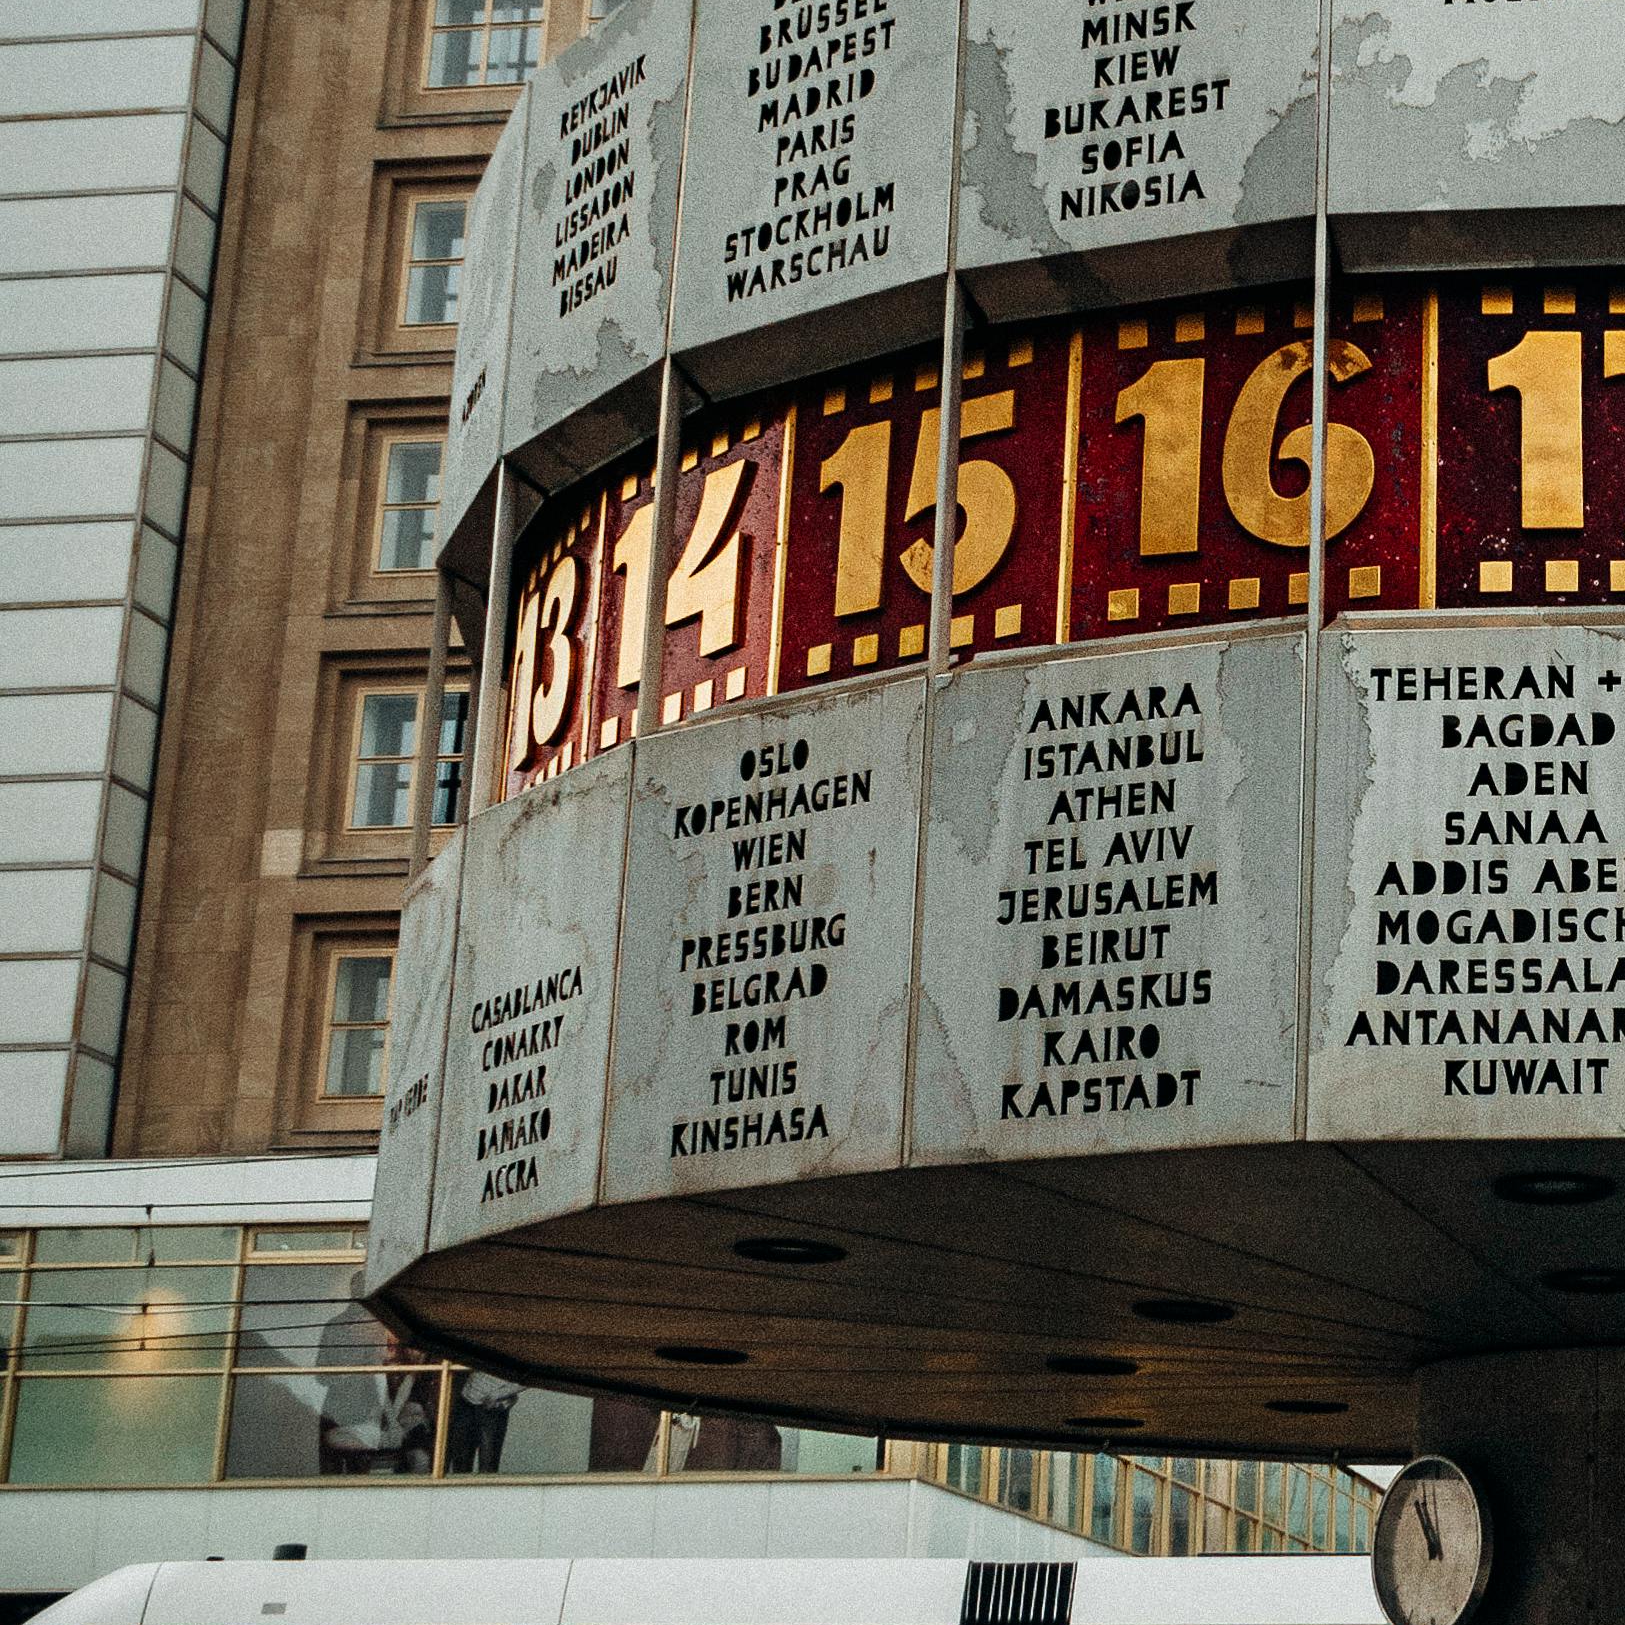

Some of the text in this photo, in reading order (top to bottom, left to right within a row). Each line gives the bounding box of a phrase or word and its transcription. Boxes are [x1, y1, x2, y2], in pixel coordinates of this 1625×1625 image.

[1081, 0, 1196, 50] MINSK
[747, 18, 896, 98] BUDAPEST
[1094, 45, 1181, 89] KIEW
[560, 54, 646, 139] REYKJAVIK
[758, 68, 875, 133] MADRID
[1044, 78, 1231, 139] BUKAREST
[571, 102, 629, 166] DUBLIN
[776, 113, 855, 167] PARIS
[1081, 130, 1185, 175] SOFIA
[565, 138, 630, 206] LONDON
[774, 154, 851, 208] PRAG
[1060, 169, 1206, 221] NIKOSIA
[555, 171, 635, 248] LISSABON
[724, 182, 895, 264] STOCKHOLM
[552, 213, 630, 287] MADEIRA
[727, 225, 890, 303] WARSCHAU
[559, 256, 617, 318] BISSAU
[1114, 339, 1374, 557] 16
[821, 390, 1016, 616] 15
[613, 459, 745, 688] 14
[513, 556, 577, 772] 13
[1370, 665, 1575, 702] TEHERAN
[1027, 682, 1202, 734] ANKARA
[1442, 712, 1616, 749] BAGDAD
[739, 738, 810, 782] OSLO
[1023, 729, 1204, 781] ISTANBUL
[1467, 760, 1588, 797] ADEN
[673, 769, 873, 840] KOPENHAGEN
[1046, 778, 1176, 826] ATHEN
[1445, 809, 1608, 846] SANAA
[732, 828, 807, 872] WIEN
[1024, 824, 1194, 875] TEL AVIV
[727, 873, 803, 919] BERN
[996, 870, 1218, 926] JERUSALEM
[1375, 859, 1508, 896] ADDIS
[679, 912, 846, 973] PRESSBURG
[1040, 923, 1171, 970] BEIRUT
[471, 965, 583, 1034] CASABLANCA
[691, 963, 828, 1016] BELGRAD
[997, 969, 1212, 1022] DAMASKUS
[482, 1015, 564, 1072] CONAKRY
[724, 1014, 787, 1057] ROM
[1042, 1023, 1161, 1068] KAIRO
[487, 1064, 547, 1114] DAKAR
[709, 1060, 798, 1106] TUNIS
[1000, 1069, 1201, 1120] KAPSTADT
[1444, 1058, 1609, 1096] KUWAIT
[476, 1107, 551, 1161] BAMAKO
[670, 1103, 829, 1158] KINSHASA
[480, 1156, 539, 1204] ACCRA
